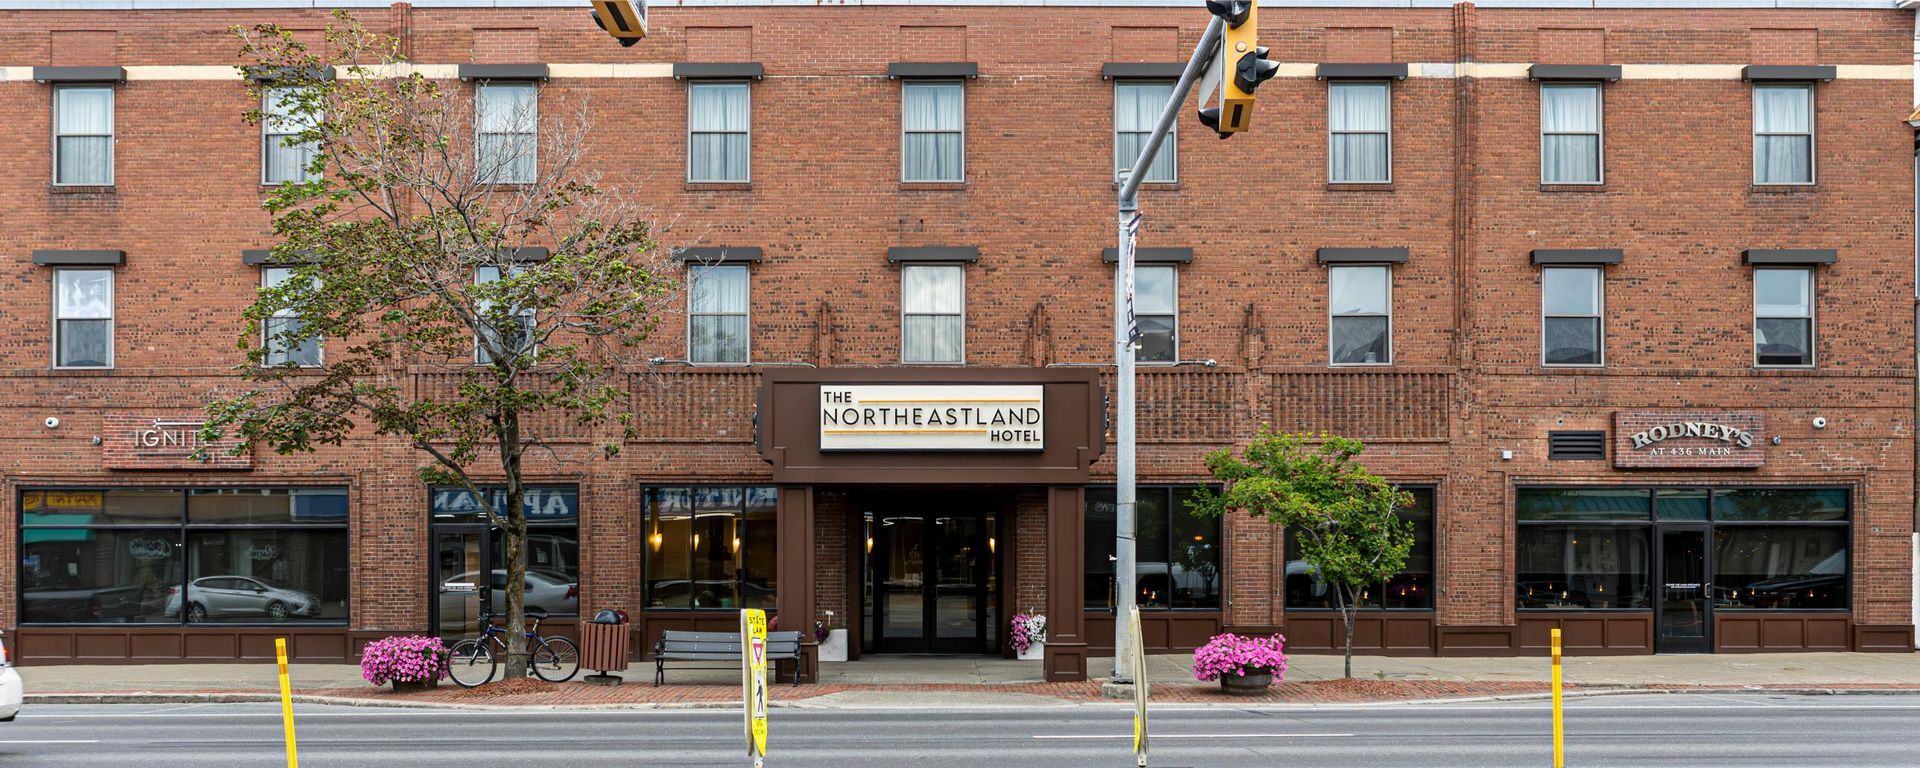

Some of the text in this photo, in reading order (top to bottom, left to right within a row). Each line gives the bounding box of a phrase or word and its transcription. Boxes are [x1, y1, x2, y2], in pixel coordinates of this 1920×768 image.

[823, 391, 852, 403] THE
[823, 407, 1041, 426] NORTHEASTLAND
[990, 430, 1041, 442] HOTEL
[1631, 421, 1754, 449] RODNEY'S
[1650, 447, 1731, 456] AT 436 MAIN
[749, 615, 765, 626] STATE
